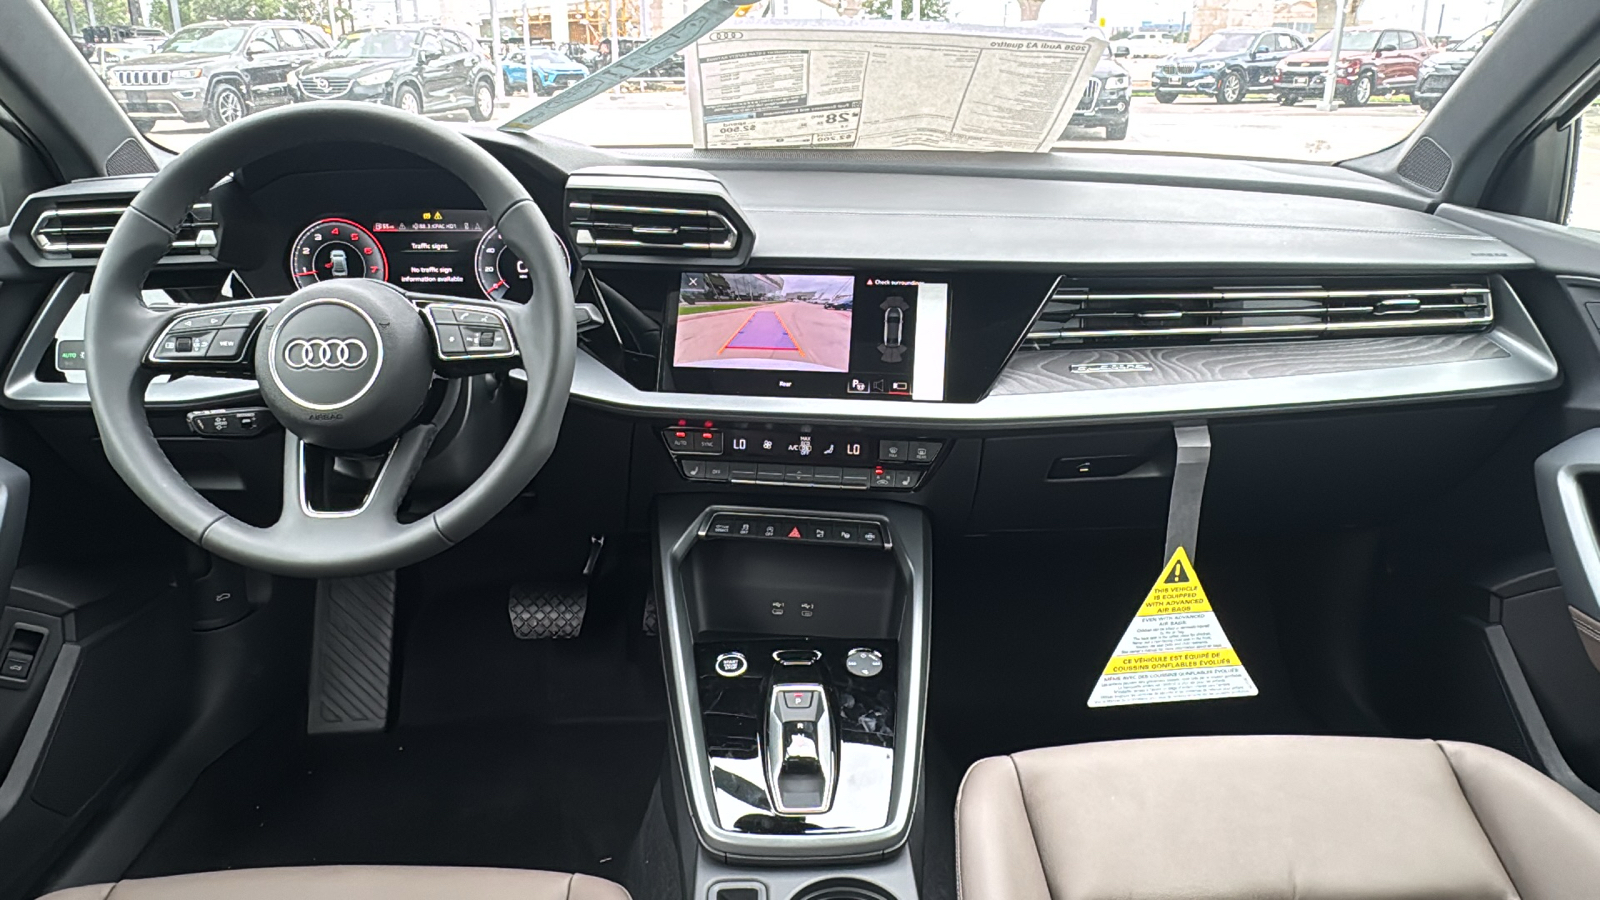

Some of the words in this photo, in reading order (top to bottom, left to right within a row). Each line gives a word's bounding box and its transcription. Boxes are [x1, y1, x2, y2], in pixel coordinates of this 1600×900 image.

[350, 232, 359, 241] 5
[411, 242, 431, 250] Traffic
[431, 242, 449, 251] signs
[302, 247, 310, 255] 2
[364, 247, 373, 255] 6
[410, 266, 420, 274] No
[420, 266, 439, 274] traffic
[440, 266, 453, 274] sign
[779, 380, 792, 388] Rear
[1162, 592, 1197, 600] EQUIPPED
[1166, 598, 1204, 606] ADVANCED
[1185, 652, 1209, 660] ÉQUIPÉ
